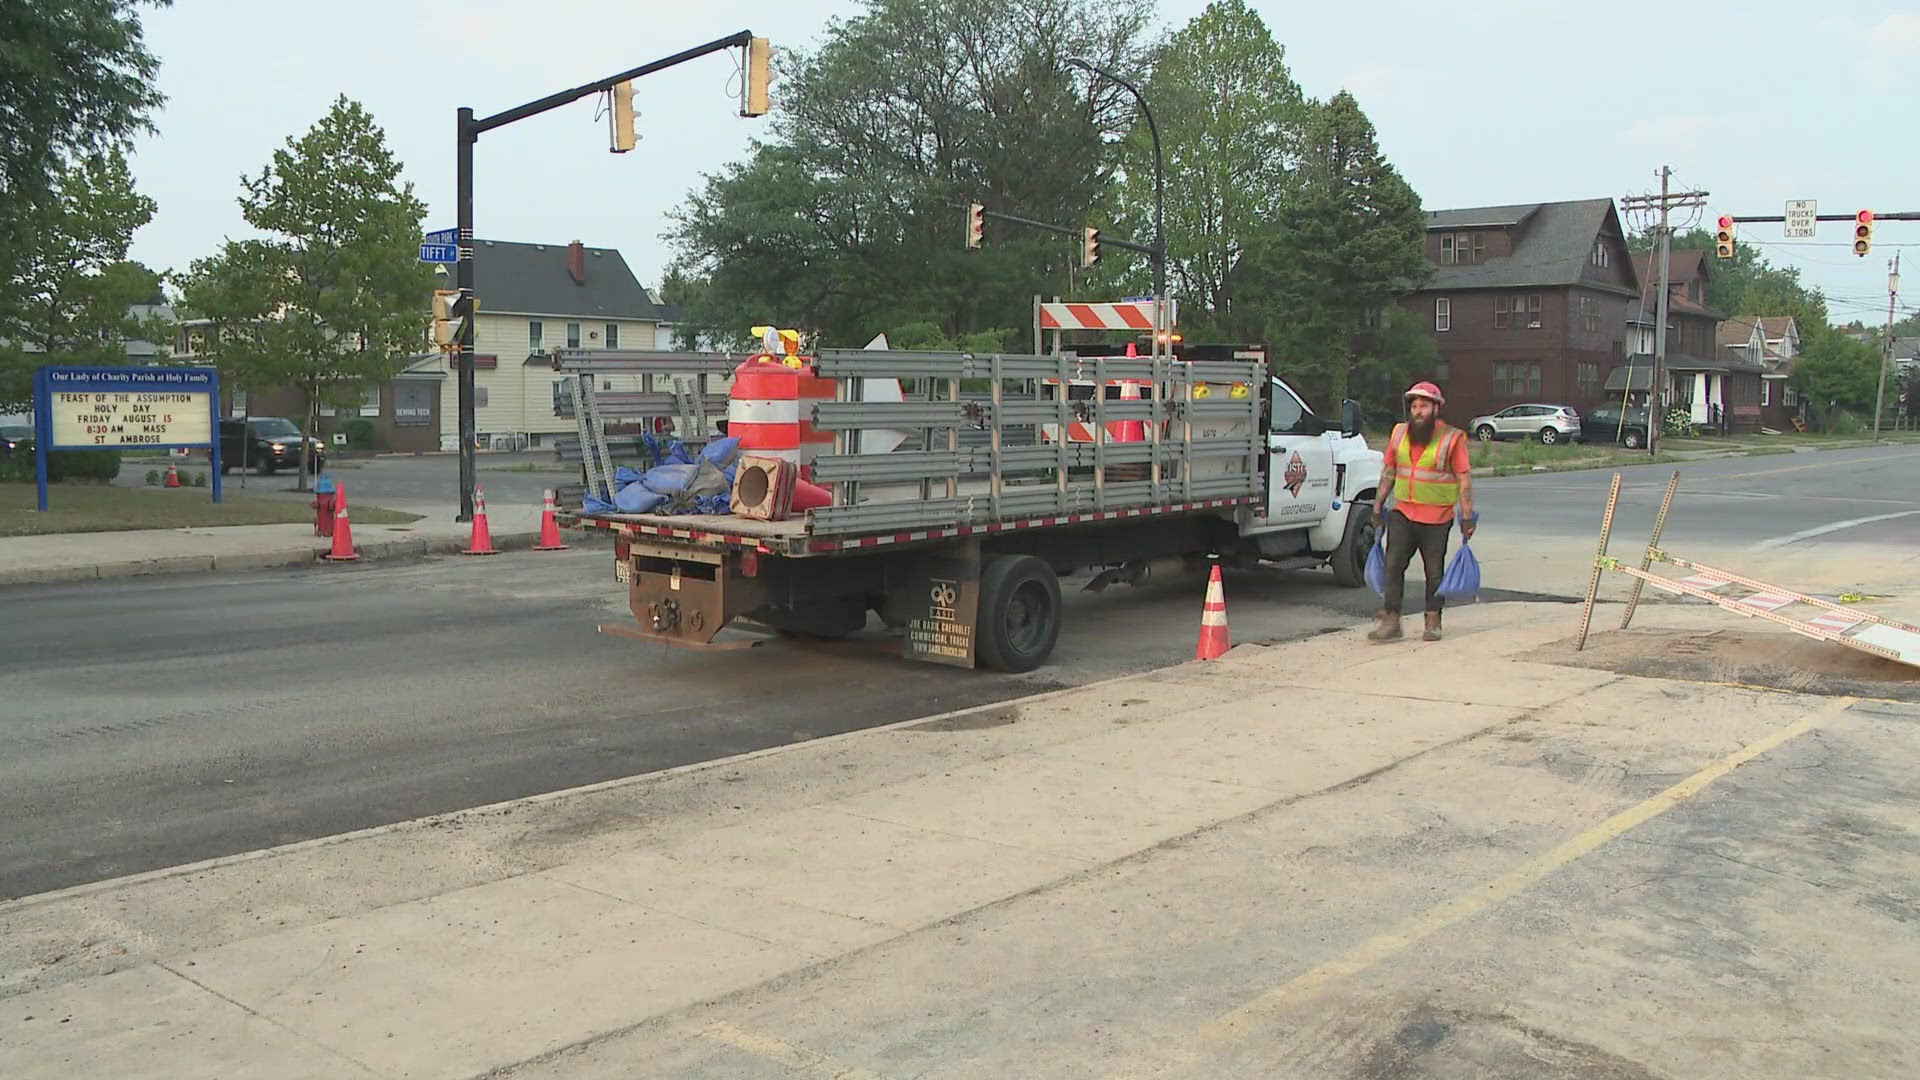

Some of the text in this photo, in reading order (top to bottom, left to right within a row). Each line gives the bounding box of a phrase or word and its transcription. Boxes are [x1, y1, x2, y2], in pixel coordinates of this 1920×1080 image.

[1796, 201, 1806, 209] NO
[1788, 210, 1814, 218] TRUCKS
[1791, 219, 1810, 227] OVER
[1787, 228, 1813, 236] 5 TONS
[421, 246, 446, 260] TIFFT
[52, 372, 209, 384] Our Lady of Charity Parish at Holy Family
[60, 394, 192, 403] FEAST OF THE ASSUMPTION
[94, 404, 150, 413] HOLY DAY
[417, 408, 430, 416] TECH
[77, 414, 172, 423] FRIDAY AUGUST 15
[86, 424, 166, 434] 8:30 AM MASS
[94, 435, 161, 444] ST AMBROSE
[909, 619, 971, 636] JOE BASIL CHEVROLET
[910, 630, 969, 648] COMMERCIAL TRUCKS
